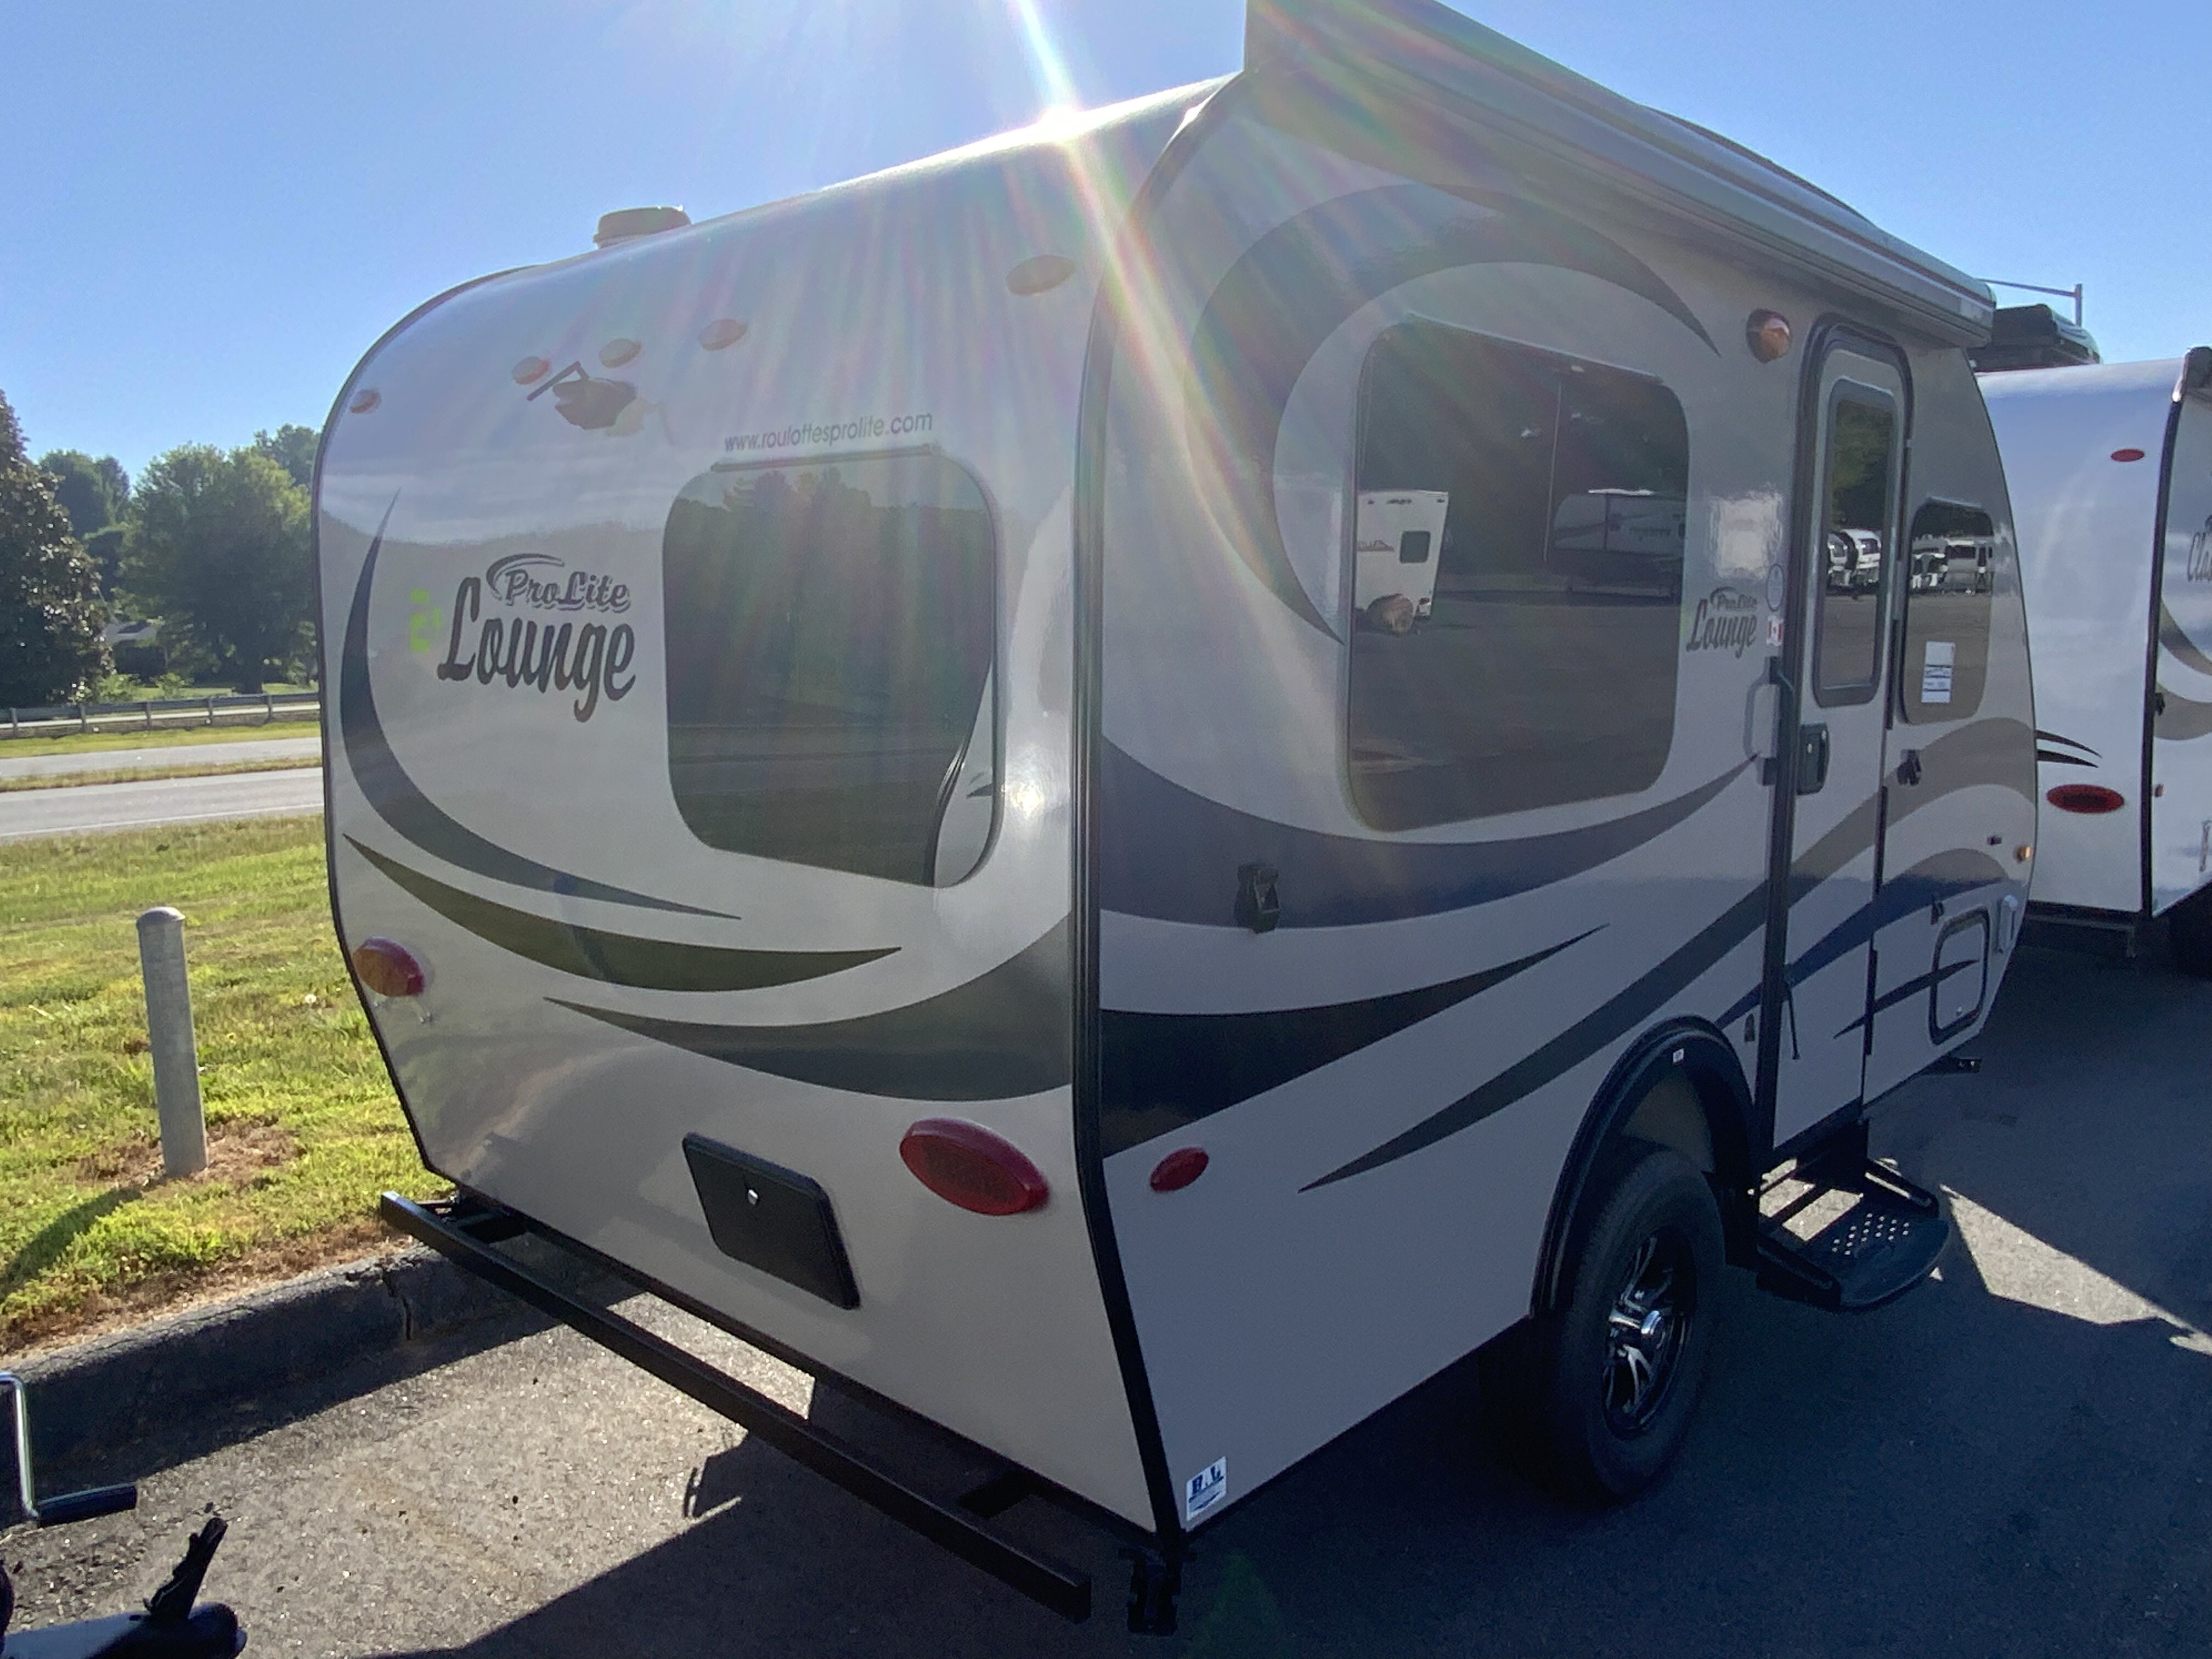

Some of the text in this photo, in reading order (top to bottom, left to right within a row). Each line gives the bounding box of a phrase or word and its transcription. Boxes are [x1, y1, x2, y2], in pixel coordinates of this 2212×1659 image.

[724, 412, 933, 452] www.roulottesprolite.com
[503, 568, 631, 613] ProLite
[437, 576, 636, 723] Lounge
[1686, 598, 1757, 659] Lounge
